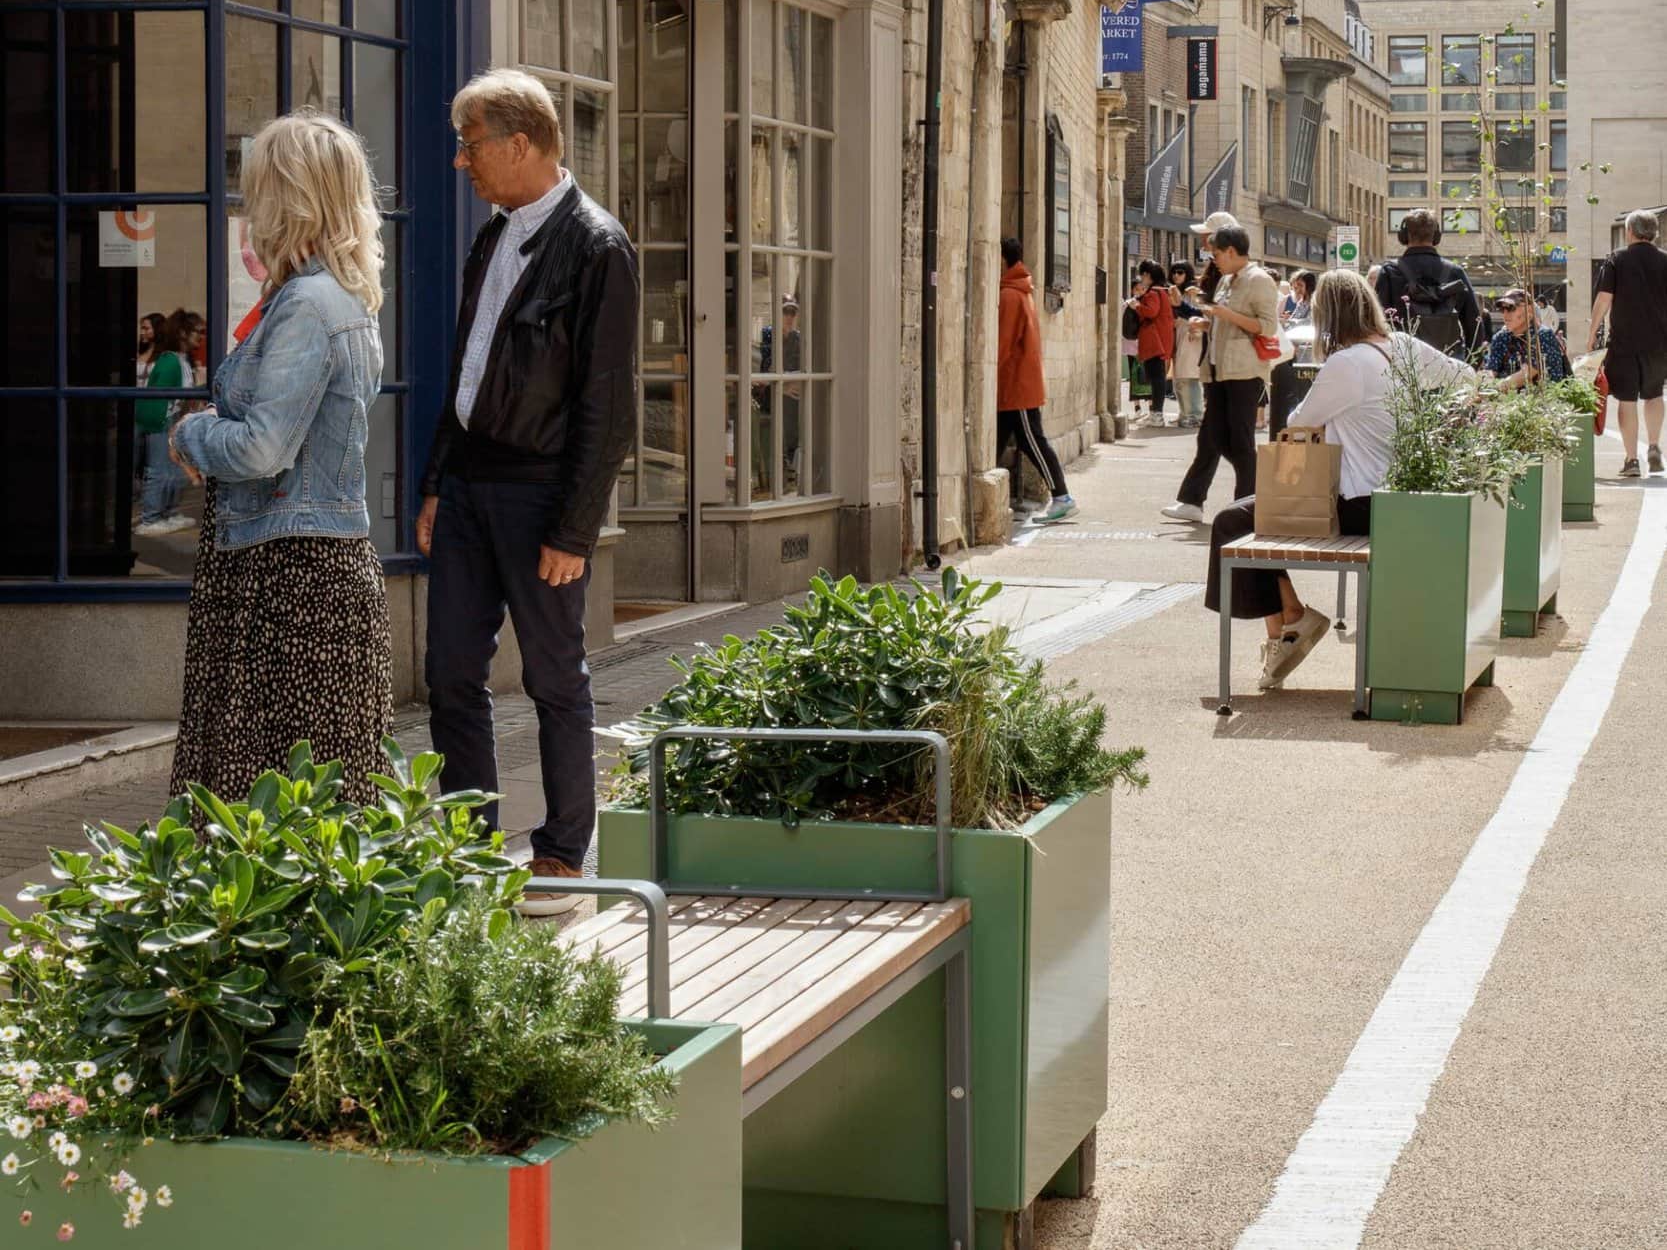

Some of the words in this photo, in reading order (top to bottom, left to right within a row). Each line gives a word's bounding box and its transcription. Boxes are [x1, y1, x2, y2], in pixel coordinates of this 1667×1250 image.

[1102, 16, 1140, 26] VERED
[1101, 29, 1137, 38] ARKET
[1112, 52, 1129, 60] 1774
[1199, 42, 1209, 96] wagamama
[1552, 250, 1568, 261] NH
